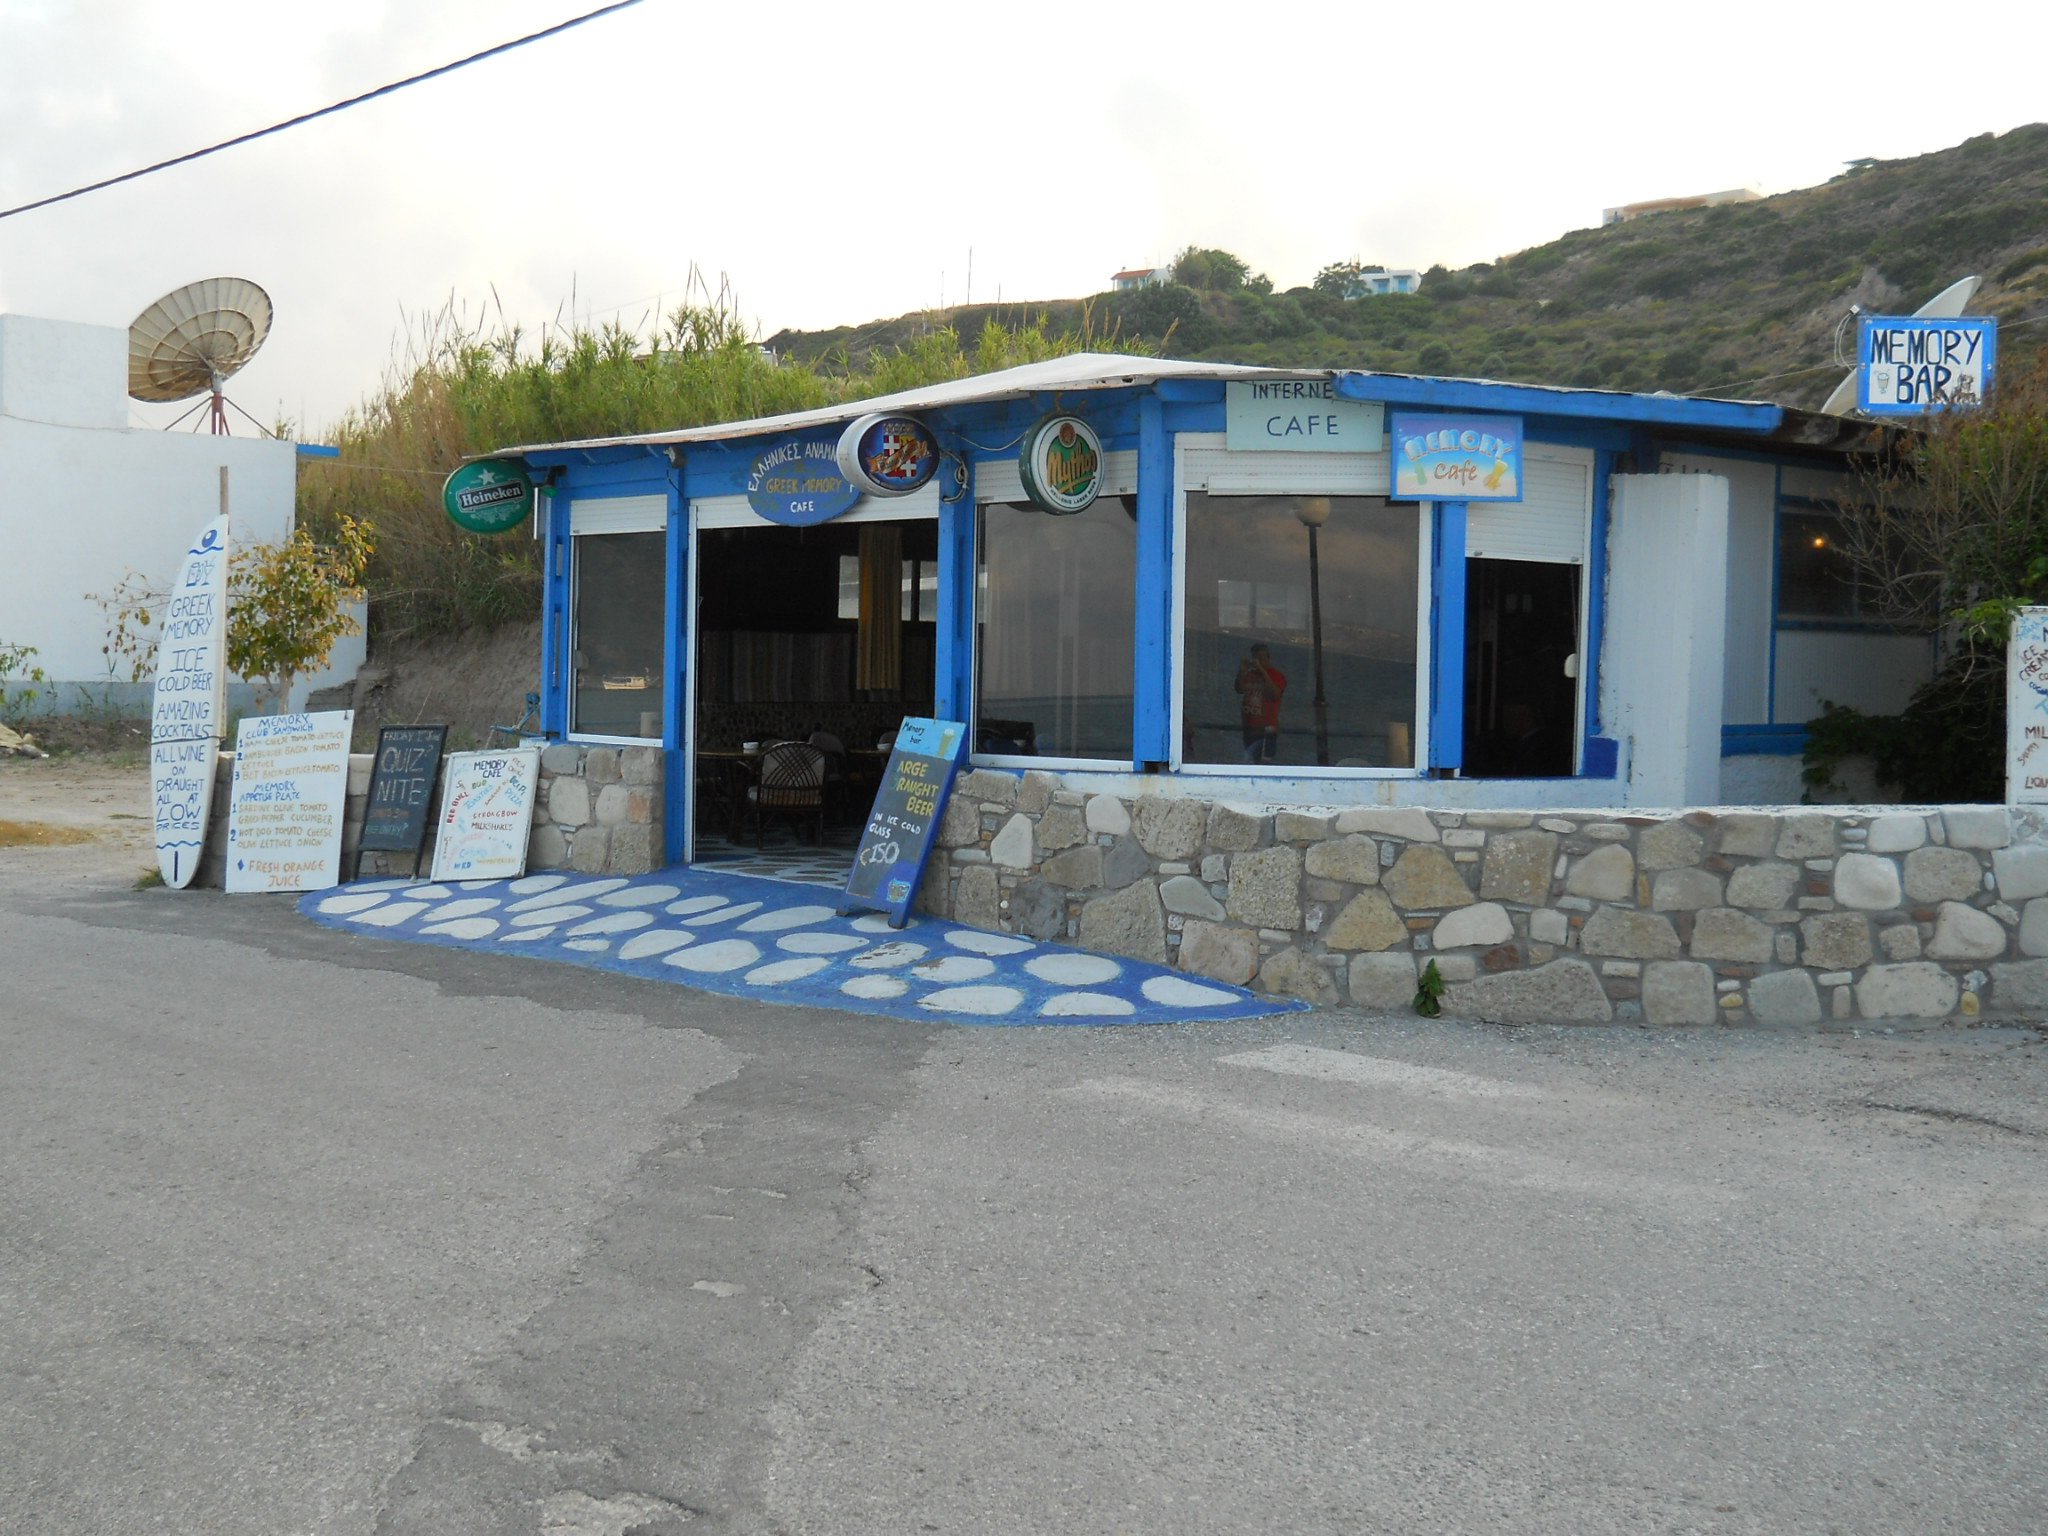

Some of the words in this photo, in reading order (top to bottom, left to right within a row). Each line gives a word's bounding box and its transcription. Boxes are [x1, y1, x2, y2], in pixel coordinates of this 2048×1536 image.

[1871, 330, 1982, 365] MEMORY
[1253, 382, 1332, 399] INTERNE
[1897, 365, 1951, 404] BAR
[1267, 415, 1339, 436] CAFE
[1405, 428, 1512, 461] MEMORY
[766, 477, 798, 494] GREEK
[801, 477, 841, 494] MEMORY
[461, 487, 521, 507] Heineken
[790, 501, 814, 512] CAFE
[171, 593, 215, 618] GREEK
[164, 617, 214, 641] MEMORY
[170, 647, 208, 673] ICE
[158, 676, 190, 692] COLD
[192, 672, 212, 691] BEER
[156, 701, 210, 720] AMAZING
[258, 714, 310, 728] MEMORY
[152, 724, 213, 739] COCKTAILS
[246, 727, 269, 740] CLUB
[272, 724, 314, 736] SANDWICH
[2025, 726, 2048, 739] MIL
[239, 739, 244, 748] 1
[155, 746, 176, 763] ALL
[179, 745, 205, 762] WINE
[237, 752, 243, 760] 2
[313, 743, 340, 752] TOMATO
[172, 766, 186, 776] ON
[234, 771, 240, 780] 3
[312, 765, 340, 774] TOMATO
[474, 759, 508, 771] MEMORY
[483, 769, 502, 779] CAFE
[156, 779, 205, 793] DRAUGHT
[254, 781, 296, 792] MEMORY
[2024, 776, 2048, 789] LIQU
[156, 794, 171, 806] ALL
[188, 793, 199, 804] AT
[906, 796, 934, 816] BEER
[156, 804, 201, 822] LOW
[232, 804, 237, 813] 1
[300, 803, 328, 812] TOMATO
[156, 822, 199, 831] PRICES
[291, 813, 333, 825] CUCUMBER
[874, 812, 883, 821] IN
[887, 815, 898, 825] ICE
[901, 821, 921, 835] COLD
[230, 829, 236, 841] 2
[275, 826, 303, 836] TOMATO
[869, 823, 891, 838] GLASS
[249, 860, 280, 873] FRESH
[283, 860, 325, 872] ORANGE
[268, 875, 301, 887] JUICE
